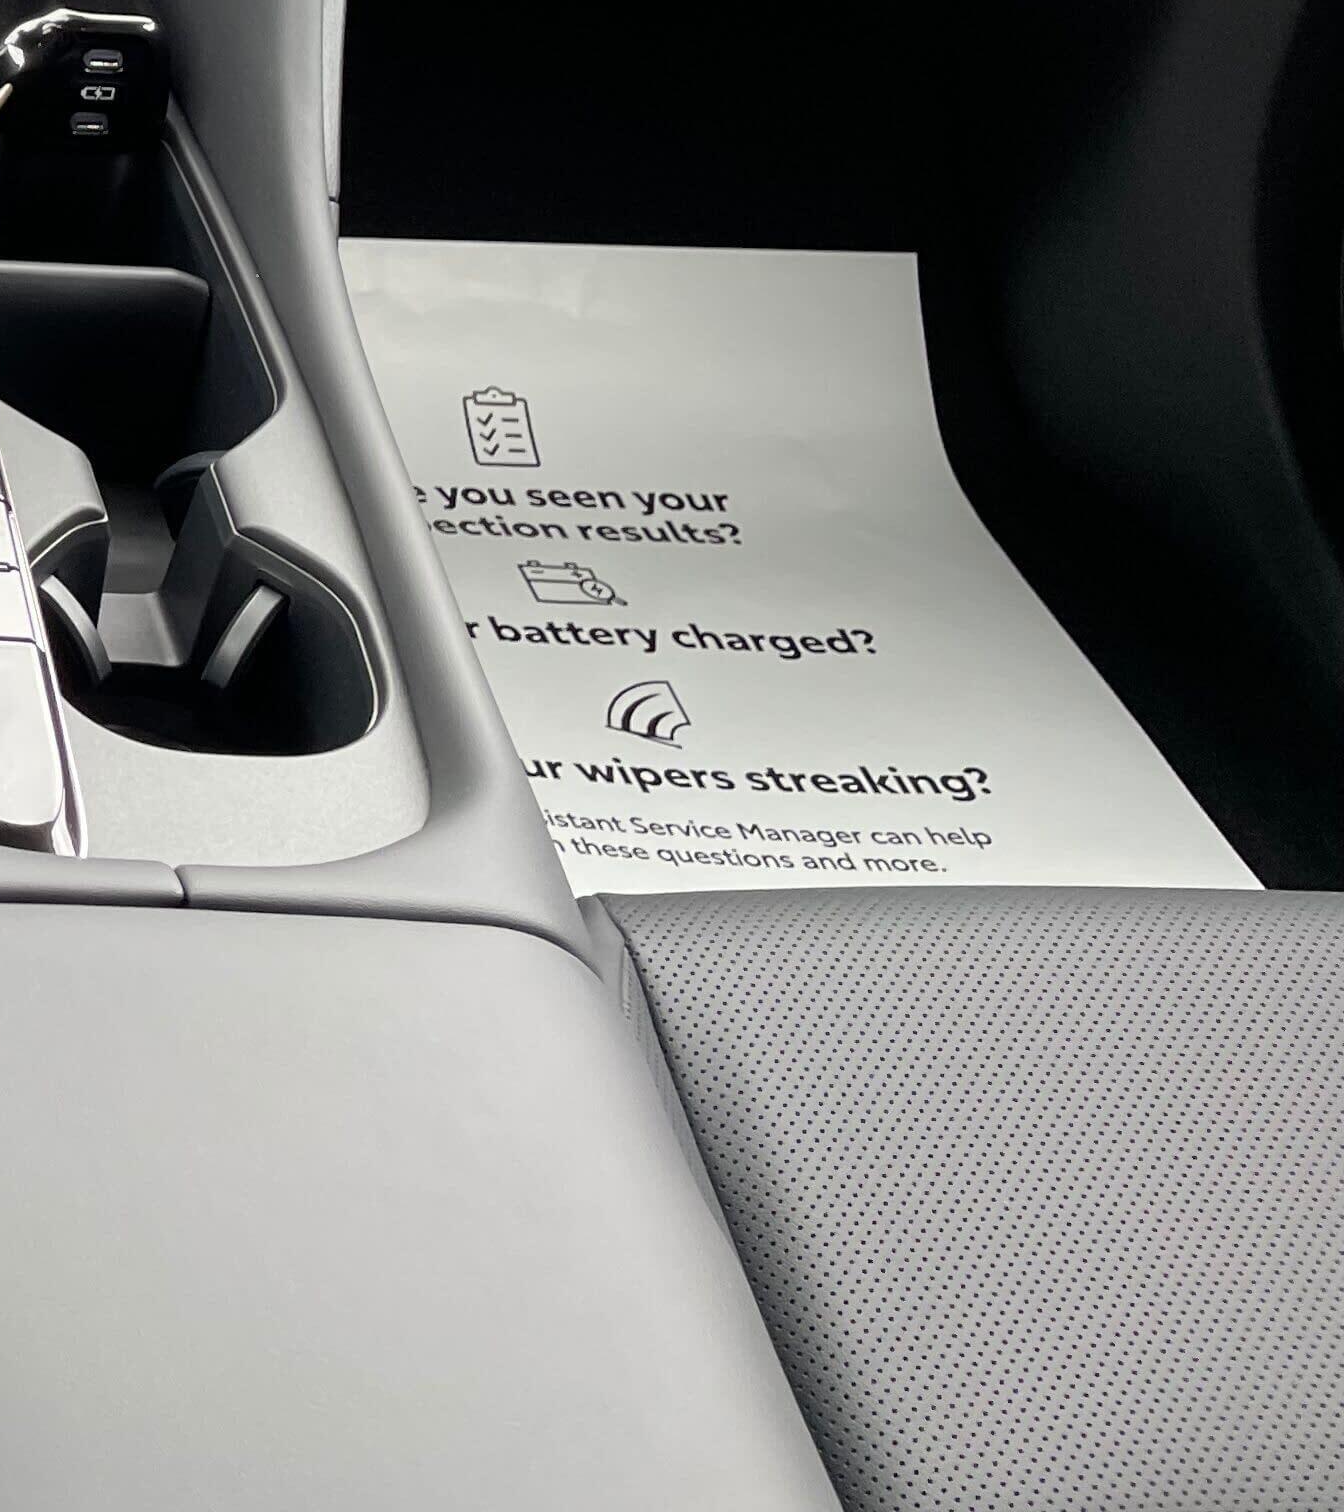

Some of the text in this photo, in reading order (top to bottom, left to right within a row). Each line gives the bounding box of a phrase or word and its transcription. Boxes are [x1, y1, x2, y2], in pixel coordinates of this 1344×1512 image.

[434, 486, 516, 510] you
[526, 488, 626, 510] seen
[632, 486, 730, 515] your
[427, 515, 744, 547] ection results?
[488, 615, 658, 654] battery
[672, 624, 878, 660] charged?
[524, 757, 994, 802] ur wipers streaking?
[534, 809, 994, 854] istant Service Manager can help
[570, 836, 651, 860] these
[656, 845, 796, 874] questions
[801, 851, 859, 873] and
[865, 855, 948, 876] more.
